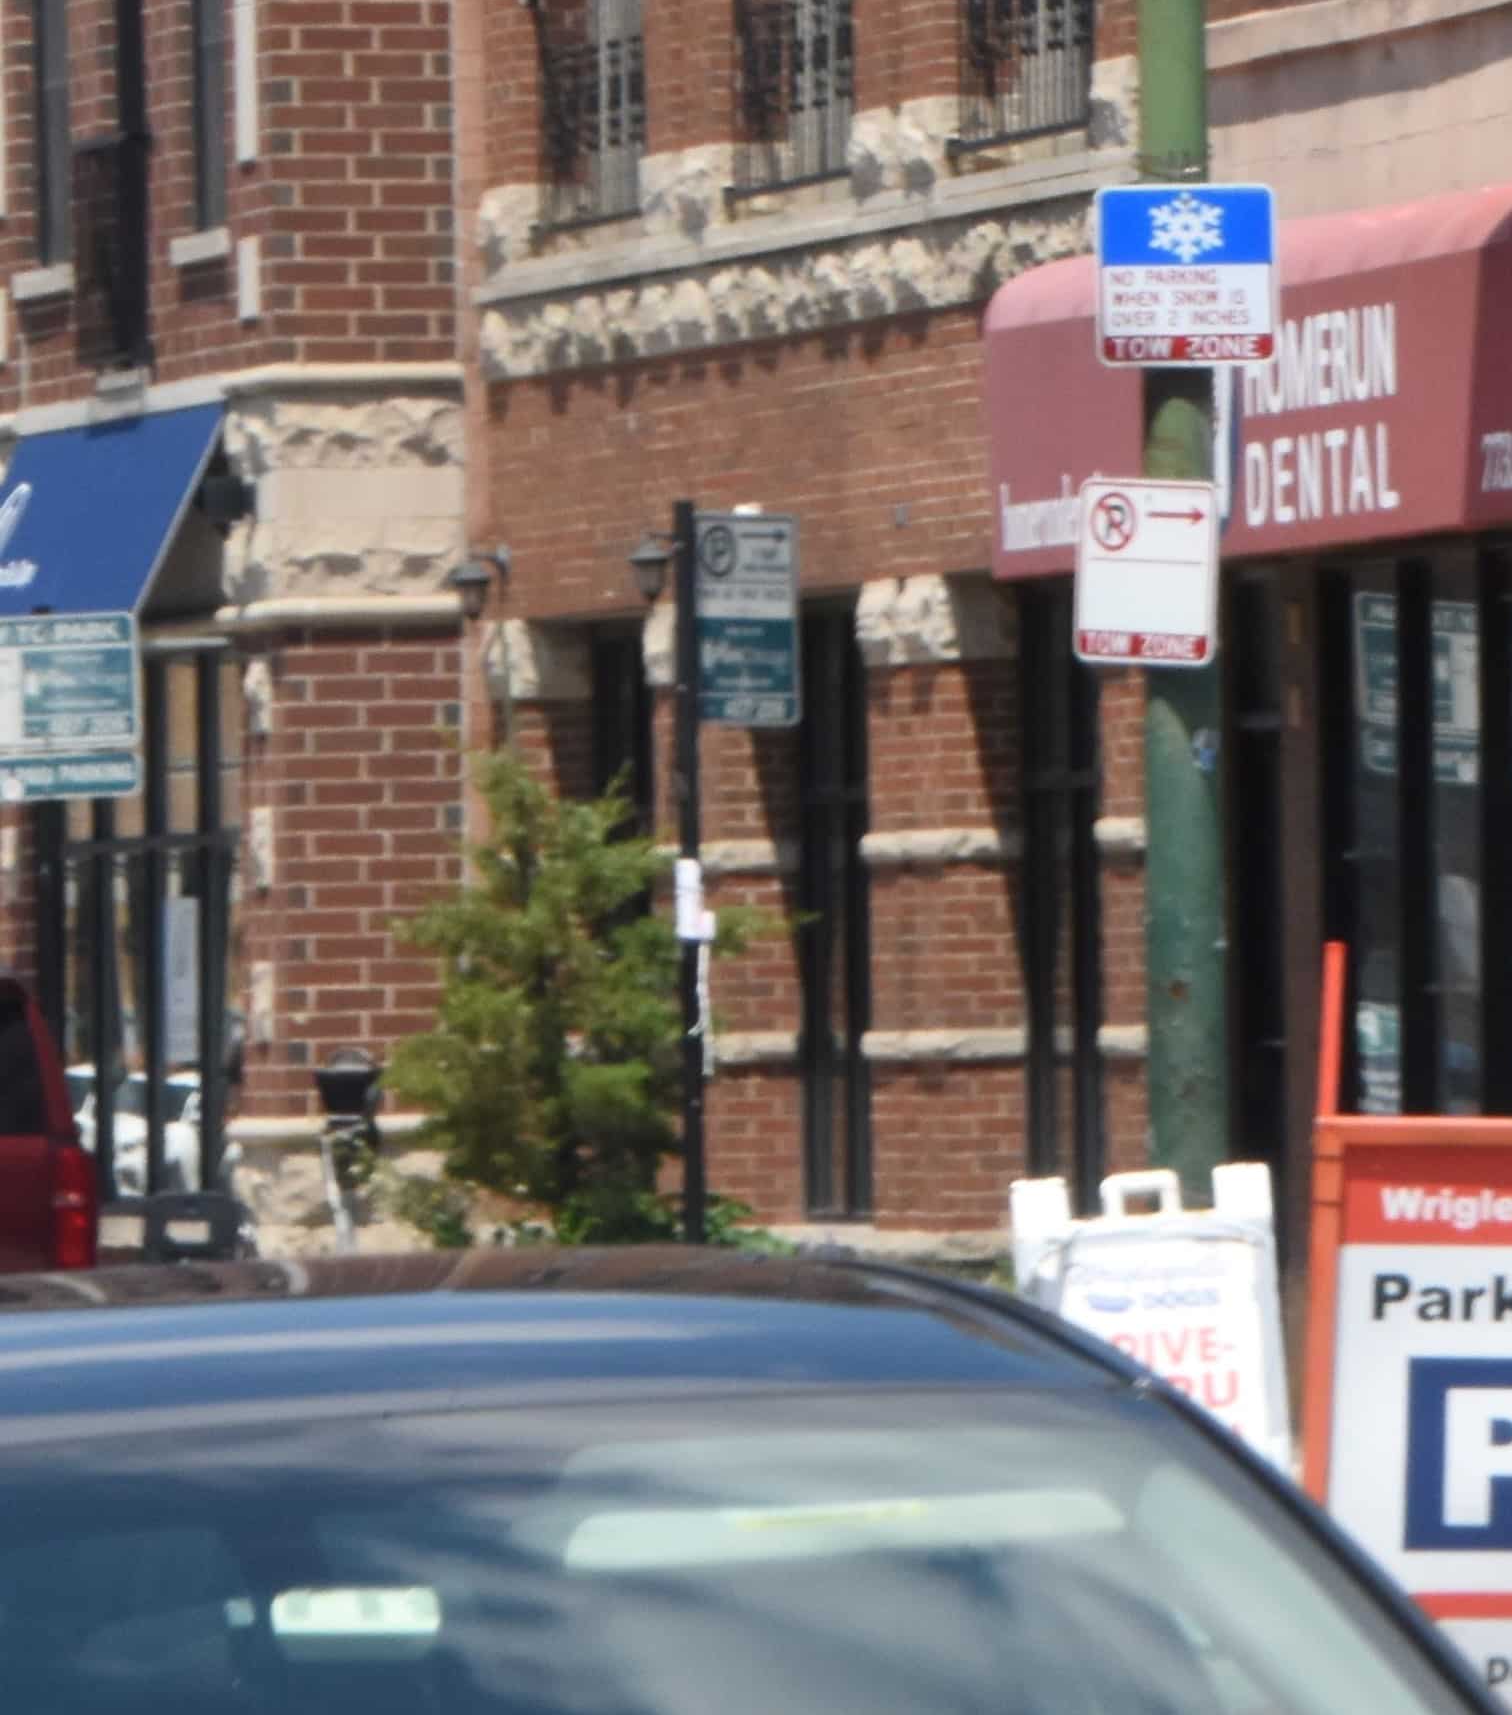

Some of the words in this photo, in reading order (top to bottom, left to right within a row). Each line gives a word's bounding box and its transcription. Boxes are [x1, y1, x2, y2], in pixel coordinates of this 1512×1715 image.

[1110, 269, 1136, 286] NO
[1144, 268, 1217, 285] PARKING
[1112, 290, 1160, 306] WHEN
[1173, 289, 1220, 306] SNOW
[1229, 288, 1247, 305] IS
[1111, 309, 1156, 326] OVER
[1168, 309, 1180, 326] 2
[1192, 308, 1251, 326] INCHES
[1111, 336, 1171, 358] TOW
[1185, 335, 1261, 358] ZONE
[1246, 420, 1401, 527] DENTAL
[1085, 632, 1129, 656] TOW
[1140, 634, 1196, 658] ZONE
